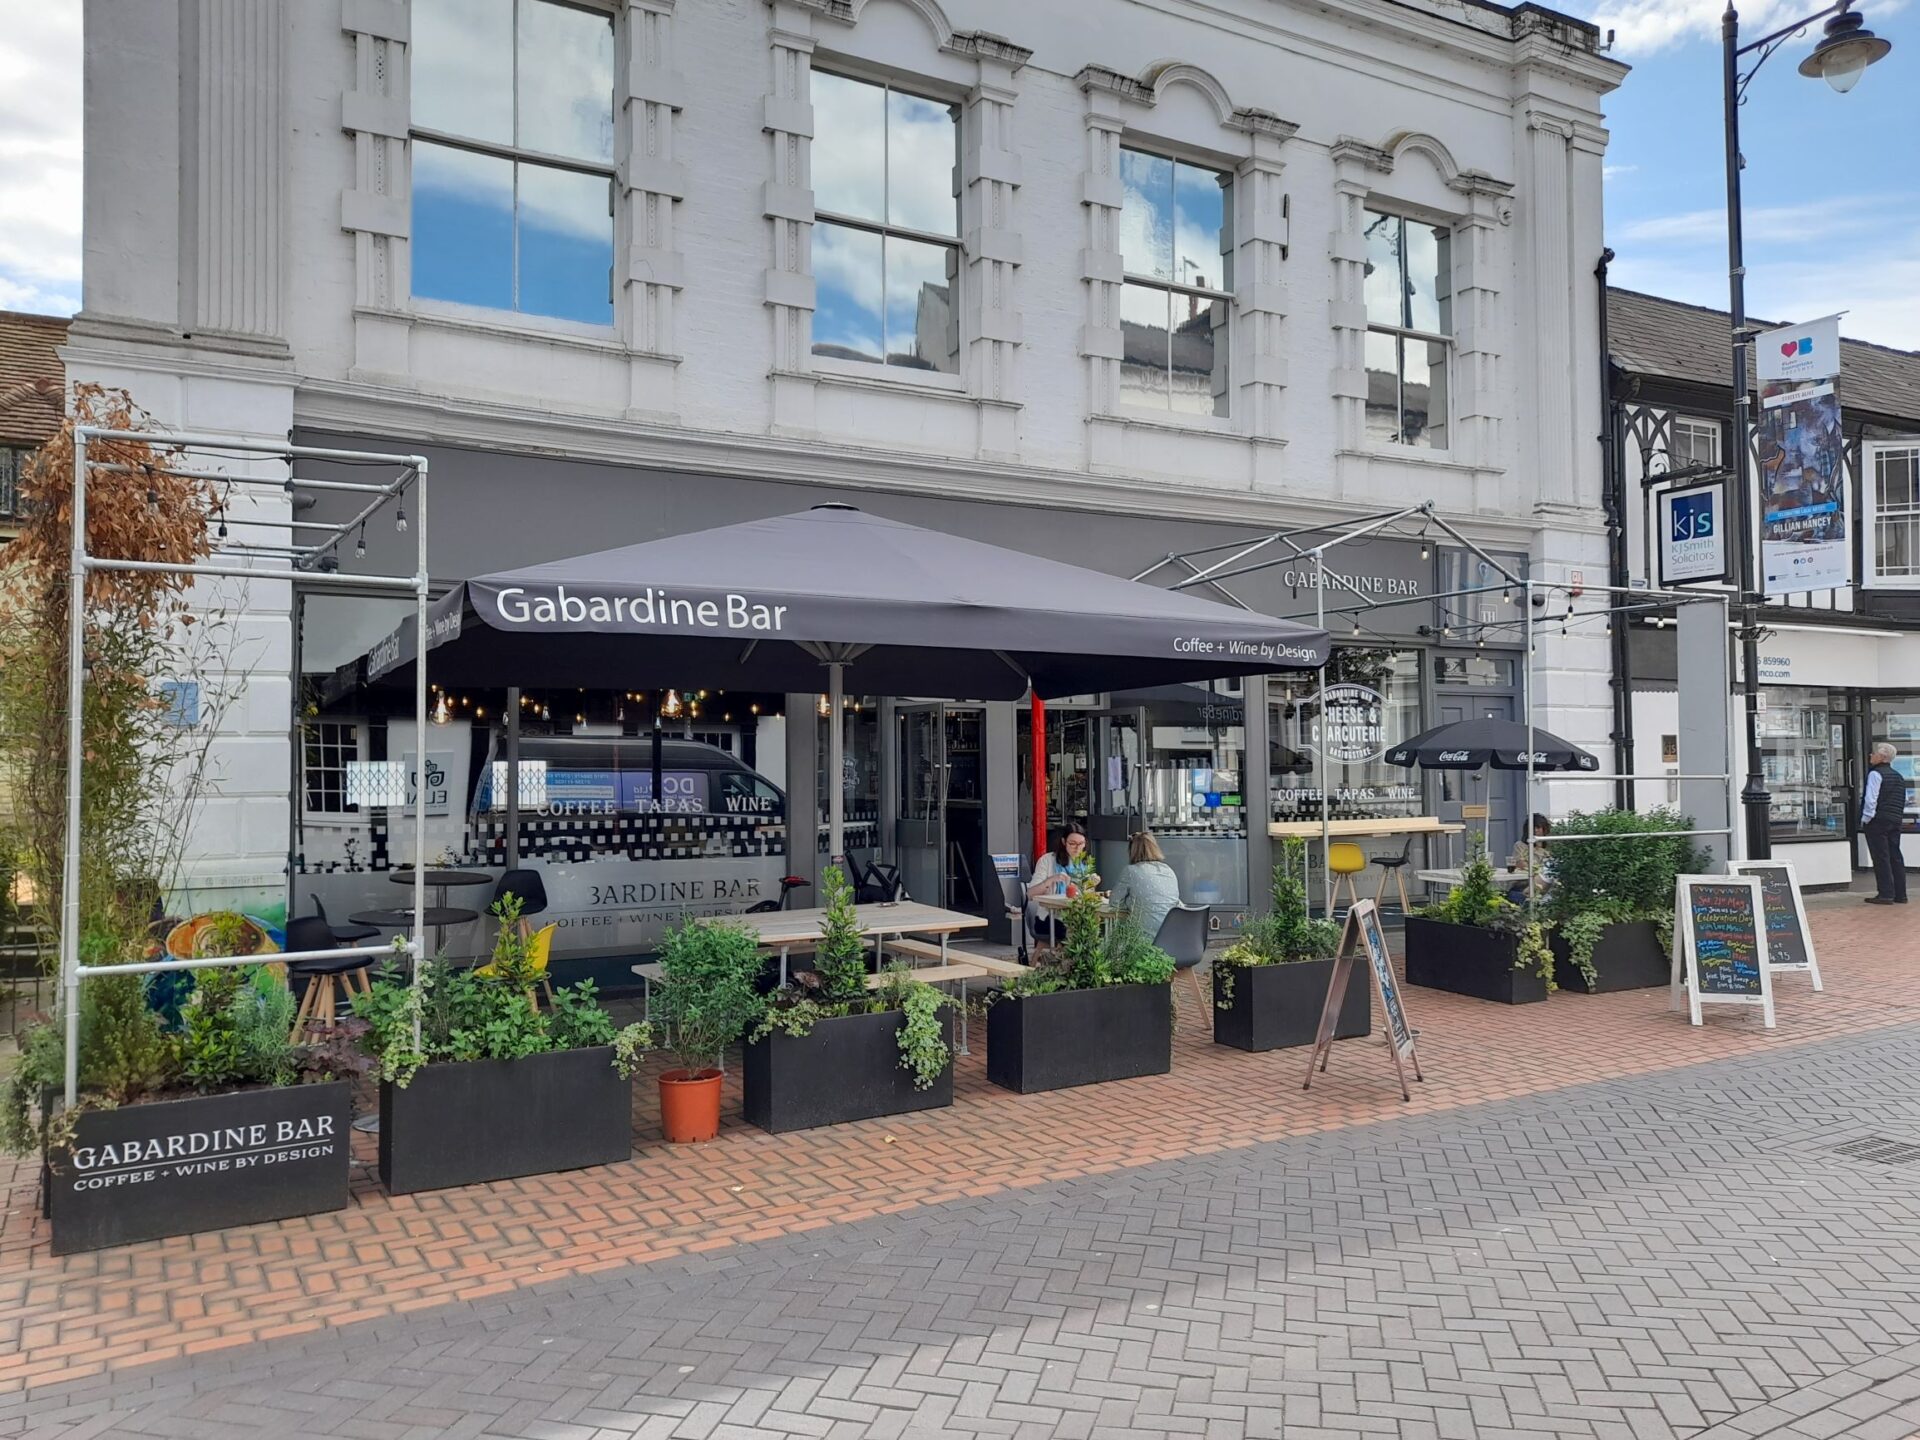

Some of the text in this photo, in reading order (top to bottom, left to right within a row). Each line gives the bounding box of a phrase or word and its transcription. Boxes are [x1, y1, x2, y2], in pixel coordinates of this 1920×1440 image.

[1673, 508, 1711, 540] kjs
[1773, 516, 1832, 534] GILLIAN HANCEY
[1671, 552, 1715, 565] Solicitors
[1284, 570, 1418, 596] GABARDINE BAR
[496, 585, 788, 631] Gabardine Bar
[1173, 637, 1317, 661] Coffee + Wine by Design
[1763, 656, 1791, 667] 859960
[1368, 706, 1377, 723] &
[1312, 725, 1386, 742] CARCUTERIE
[1278, 787, 1415, 801] COFFEE TAPAS WINE
[537, 800, 618, 817] COFFEE
[634, 797, 705, 814] TAPAS
[725, 794, 772, 812] WINE
[713, 878, 761, 899] BAR
[545, 915, 613, 929] COFFEE
[630, 912, 675, 923] WINE
[1696, 912, 1753, 927] Celebration Day
[73, 1115, 335, 1170] GABARDINE BAR
[73, 1144, 335, 1191] COFFEE + WINE BY DESIGN
